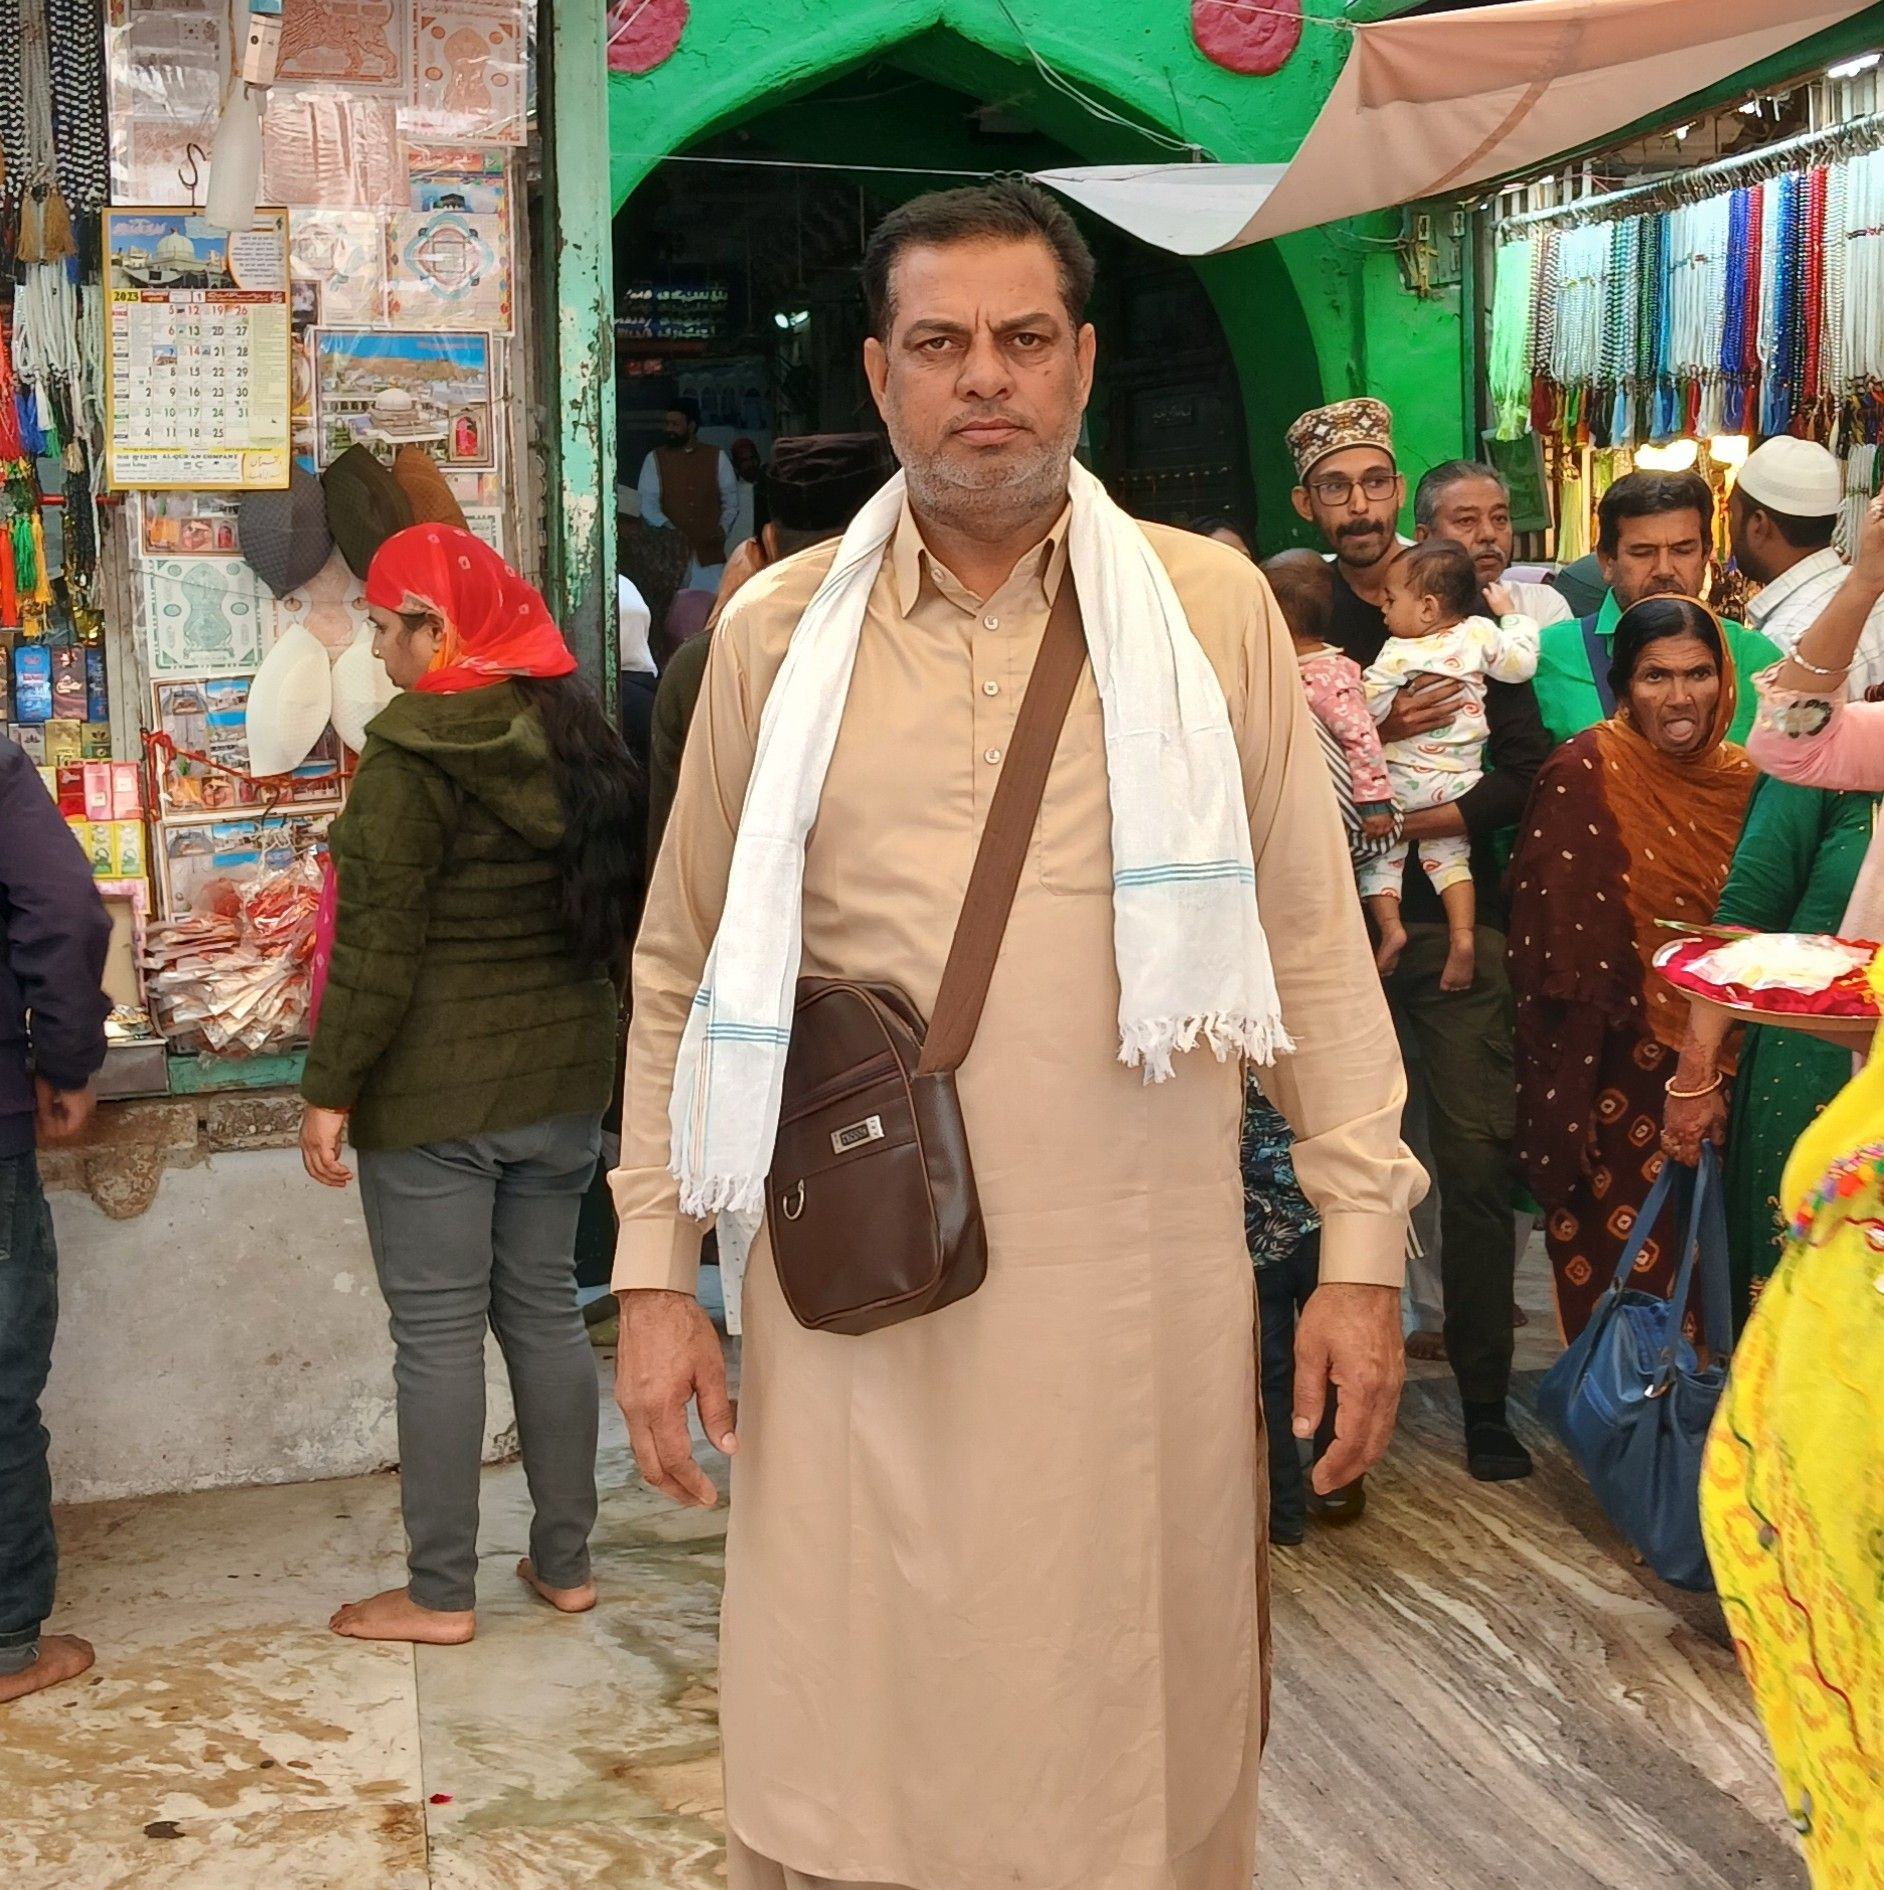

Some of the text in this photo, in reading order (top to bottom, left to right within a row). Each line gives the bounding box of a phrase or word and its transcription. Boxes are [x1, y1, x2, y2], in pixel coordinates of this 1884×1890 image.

[113, 291, 138, 301] 2023
[189, 305, 199, 315] 12
[213, 305, 222, 314] 19
[236, 306, 247, 315] 26
[189, 326, 200, 335] 13
[213, 326, 223, 335] 20
[236, 326, 247, 335] 27
[190, 347, 199, 356] 14
[215, 347, 225, 356] 21
[237, 347, 248, 356] 28
[190, 368, 200, 377] 15
[213, 368, 224, 377] 22
[237, 368, 248, 377] 29
[190, 388, 199, 396] 16
[213, 388, 223, 397] 23
[237, 388, 248, 397] 30
[165, 408, 175, 417] 10
[189, 408, 199, 417] 17
[213, 408, 223, 417] 24
[239, 408, 248, 417] 31
[167, 429, 175, 437] 11
[190, 429, 199, 437] 18
[213, 429, 223, 437] 25
